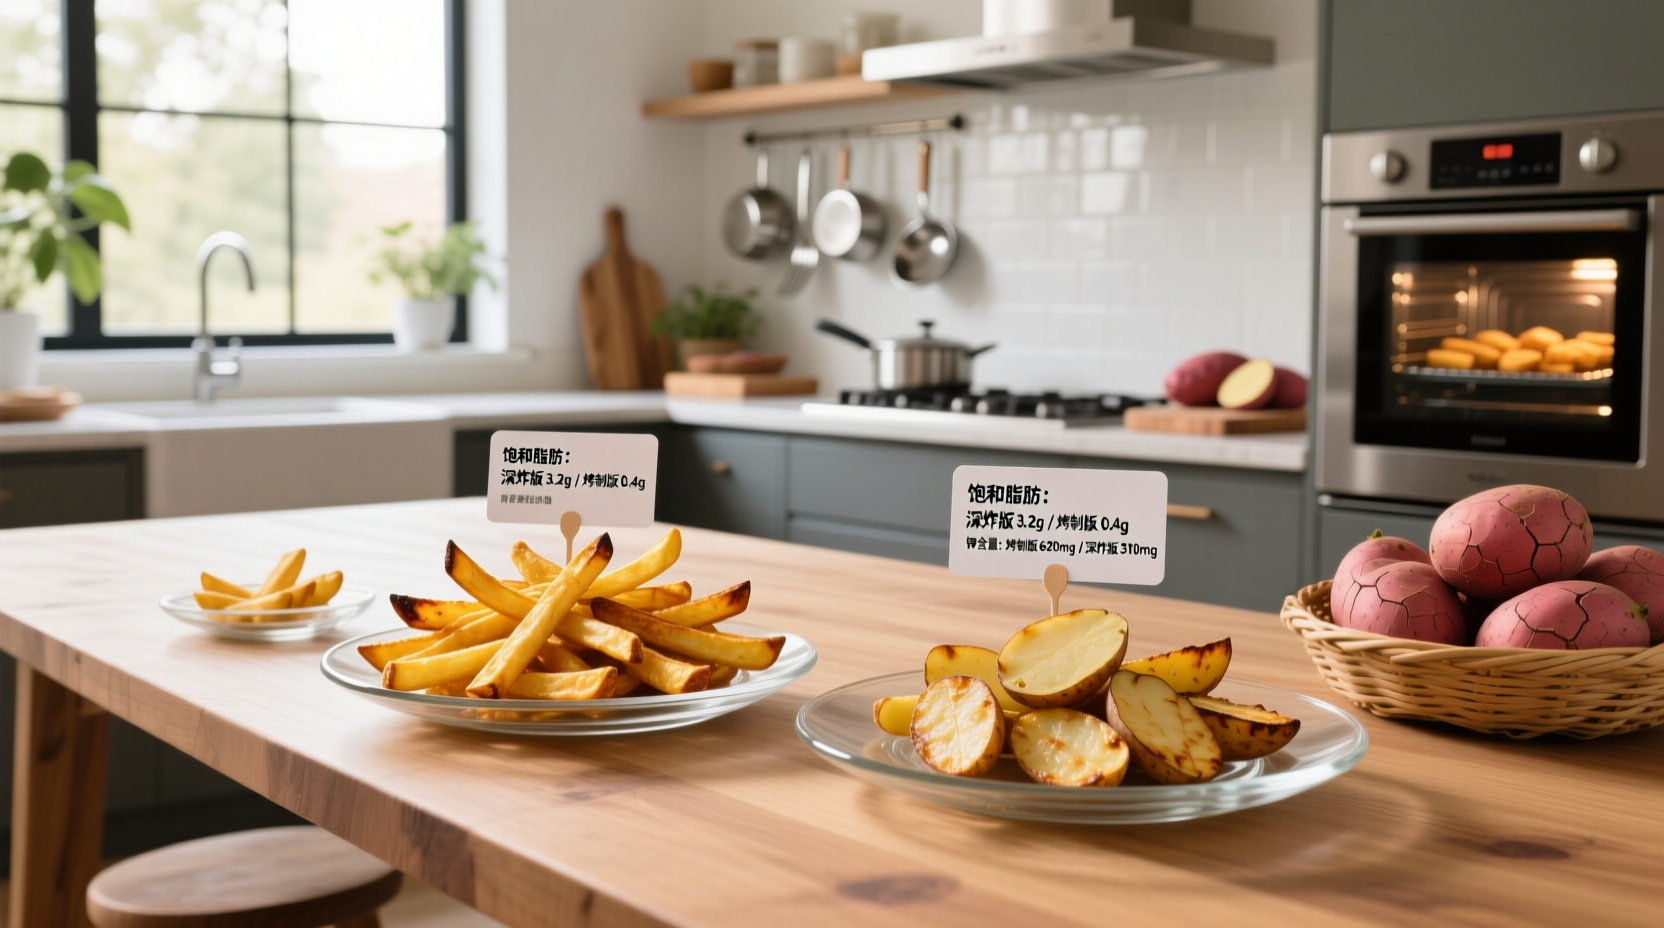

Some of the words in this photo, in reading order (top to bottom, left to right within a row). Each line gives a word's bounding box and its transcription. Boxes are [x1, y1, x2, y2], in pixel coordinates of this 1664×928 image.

[546, 473, 572, 488] 3.2g
[620, 475, 645, 491] 0.4g
[1016, 514, 1044, 532] 3.2g
[1100, 517, 1129, 535] 0.4g
[1039, 540, 1075, 556] 620mg
